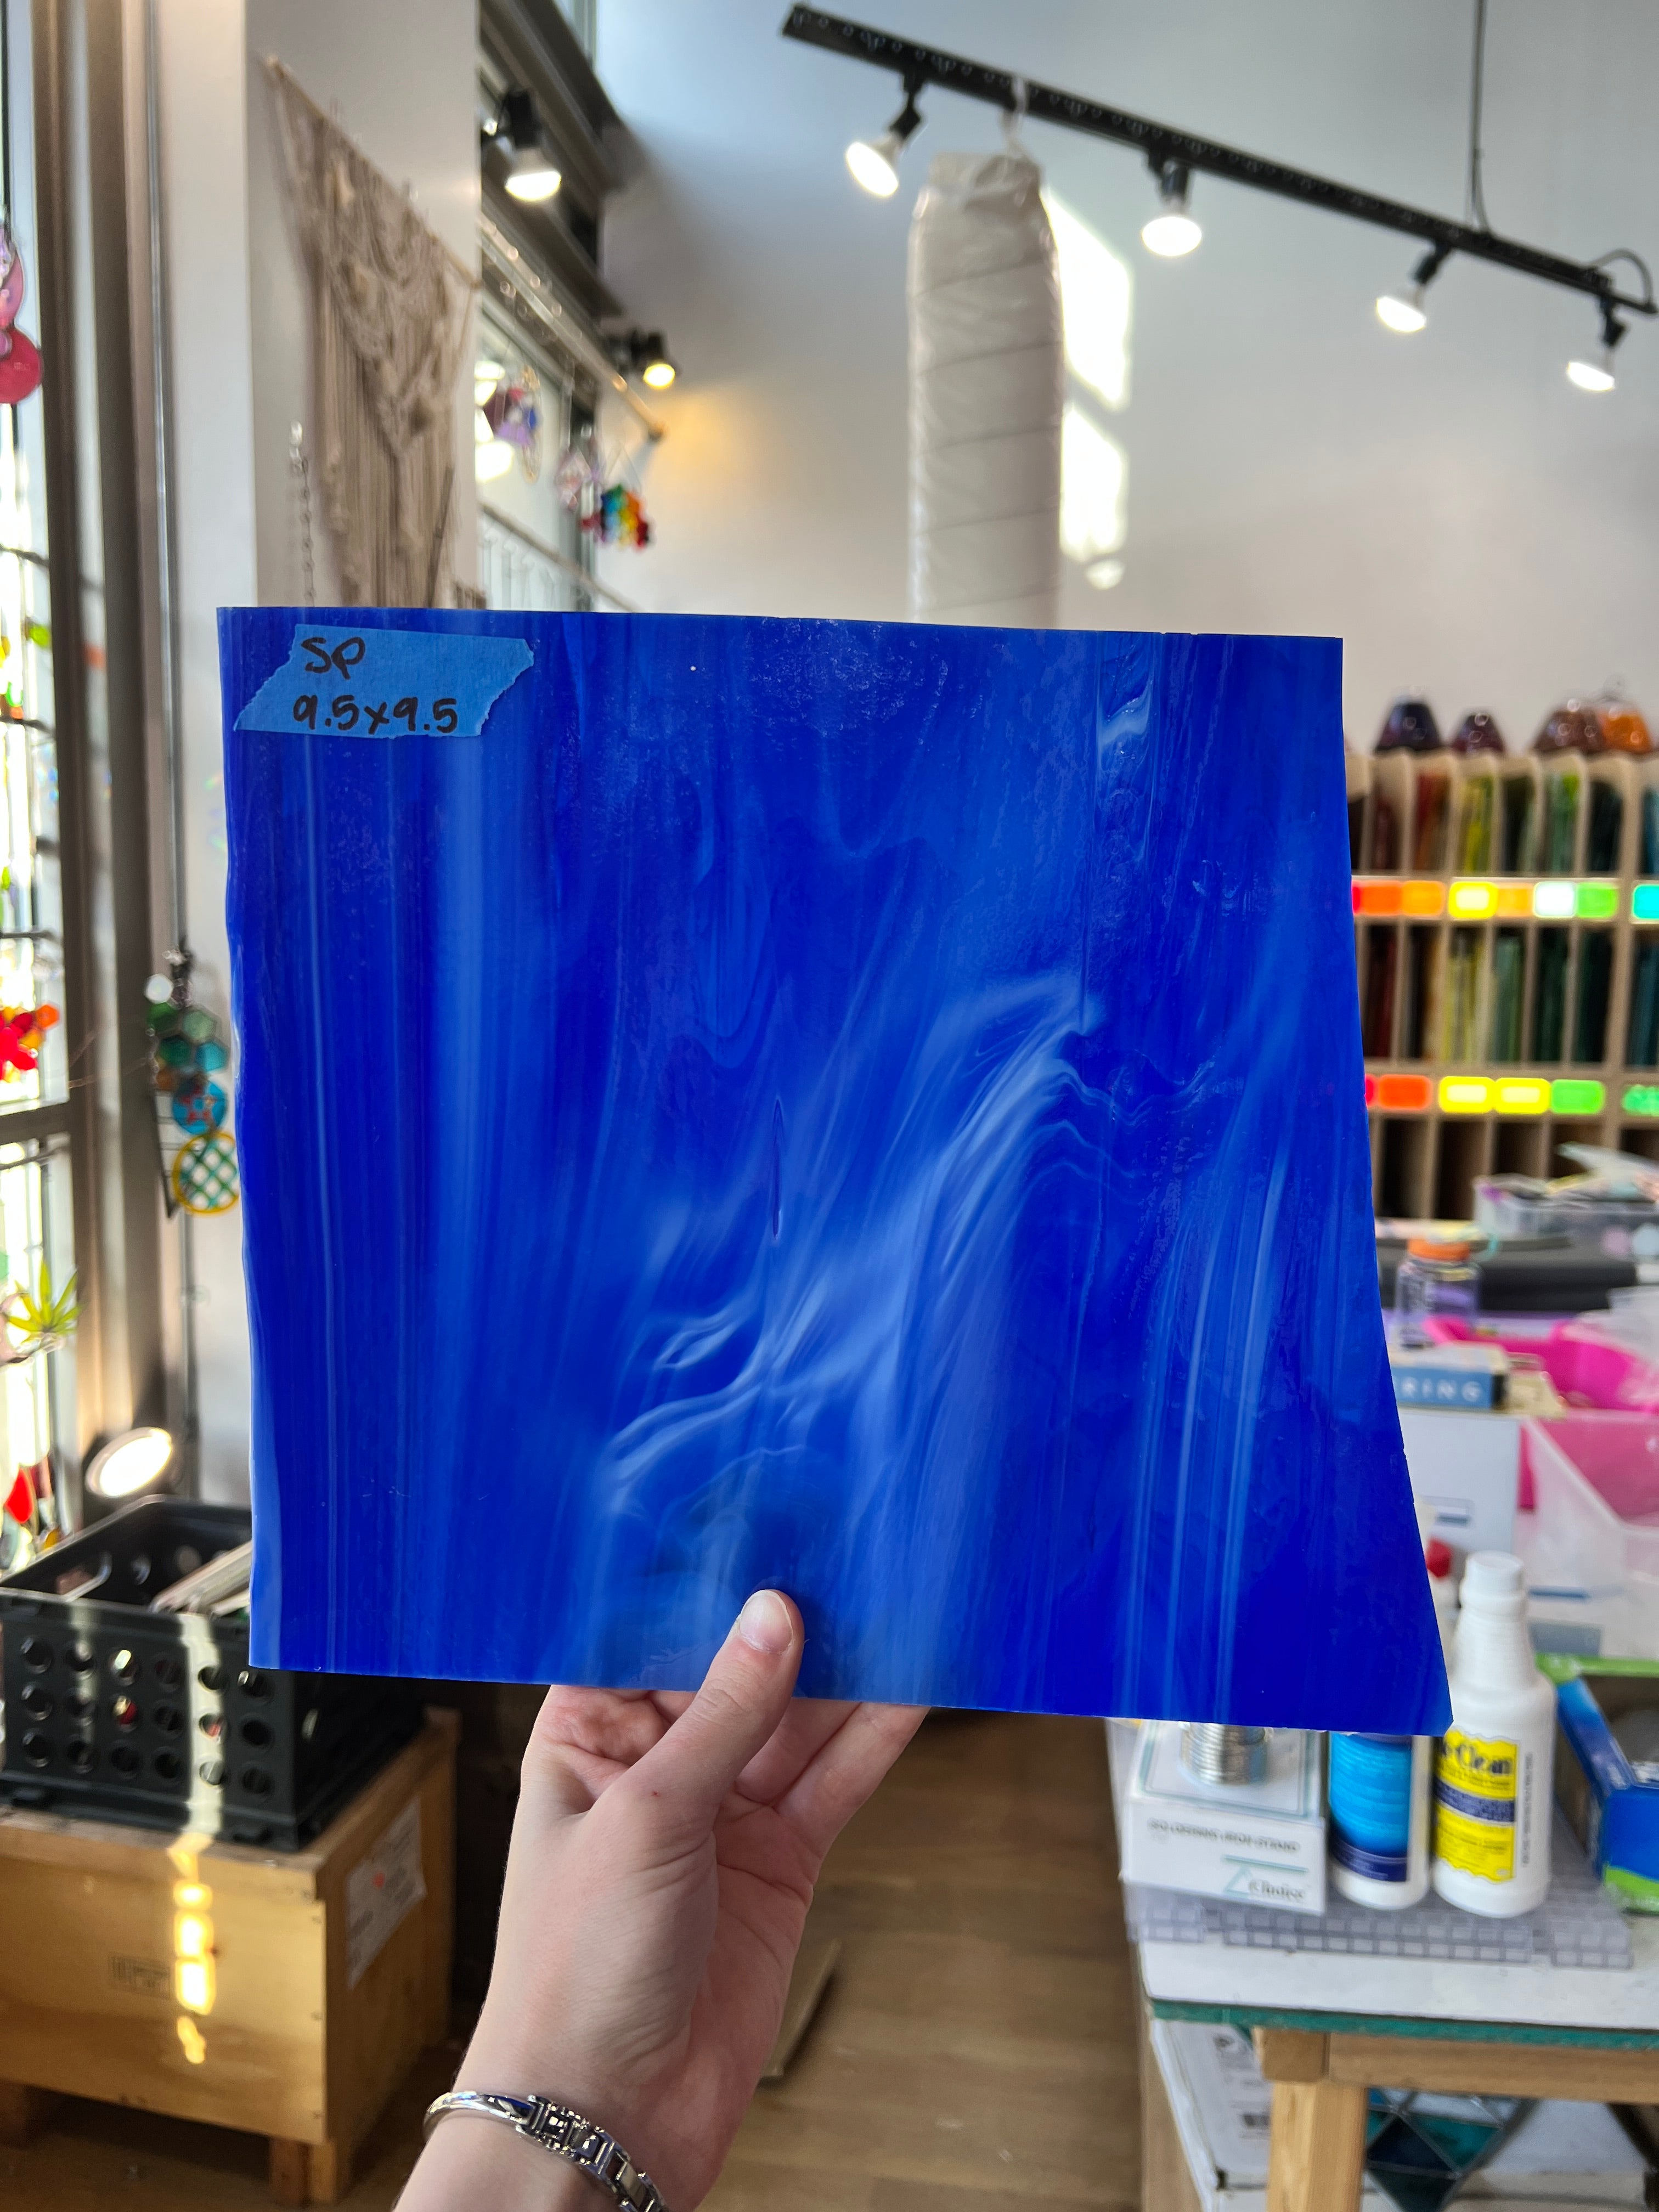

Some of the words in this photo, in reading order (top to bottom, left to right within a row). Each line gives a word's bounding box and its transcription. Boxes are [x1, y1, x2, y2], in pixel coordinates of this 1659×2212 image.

[301, 636, 366, 680] SP
[292, 694, 459, 735] 9.5x9.5
[1393, 1376, 1482, 1402] RING
